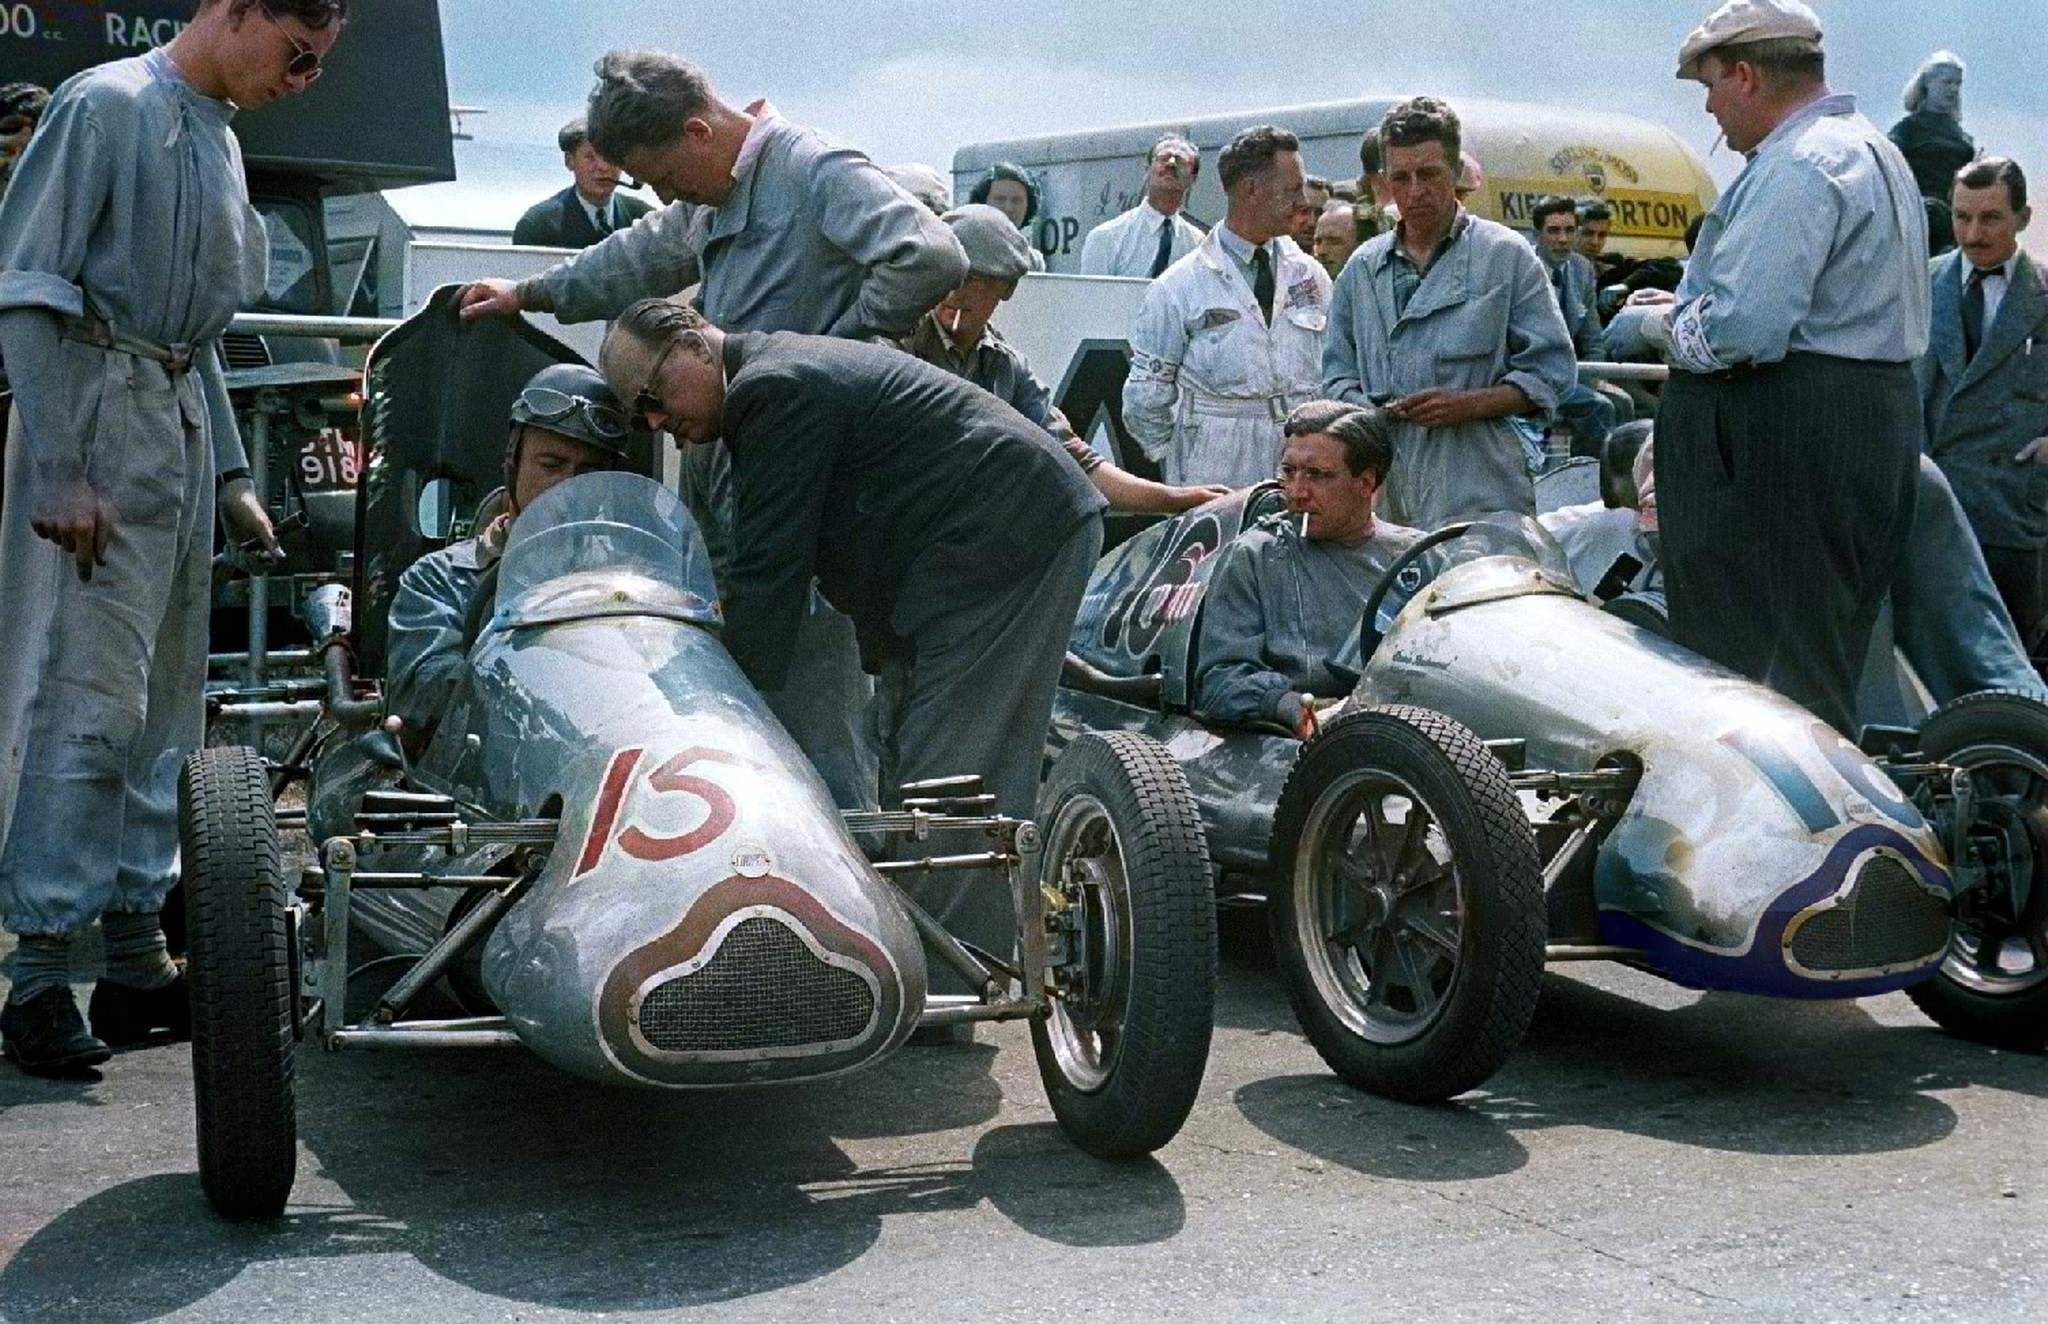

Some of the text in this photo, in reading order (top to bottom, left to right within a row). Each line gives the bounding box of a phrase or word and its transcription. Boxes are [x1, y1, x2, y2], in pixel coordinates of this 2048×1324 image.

[105, 12, 189, 48] RACI
[302, 456, 358, 484] 918
[568, 745, 756, 885] 15
